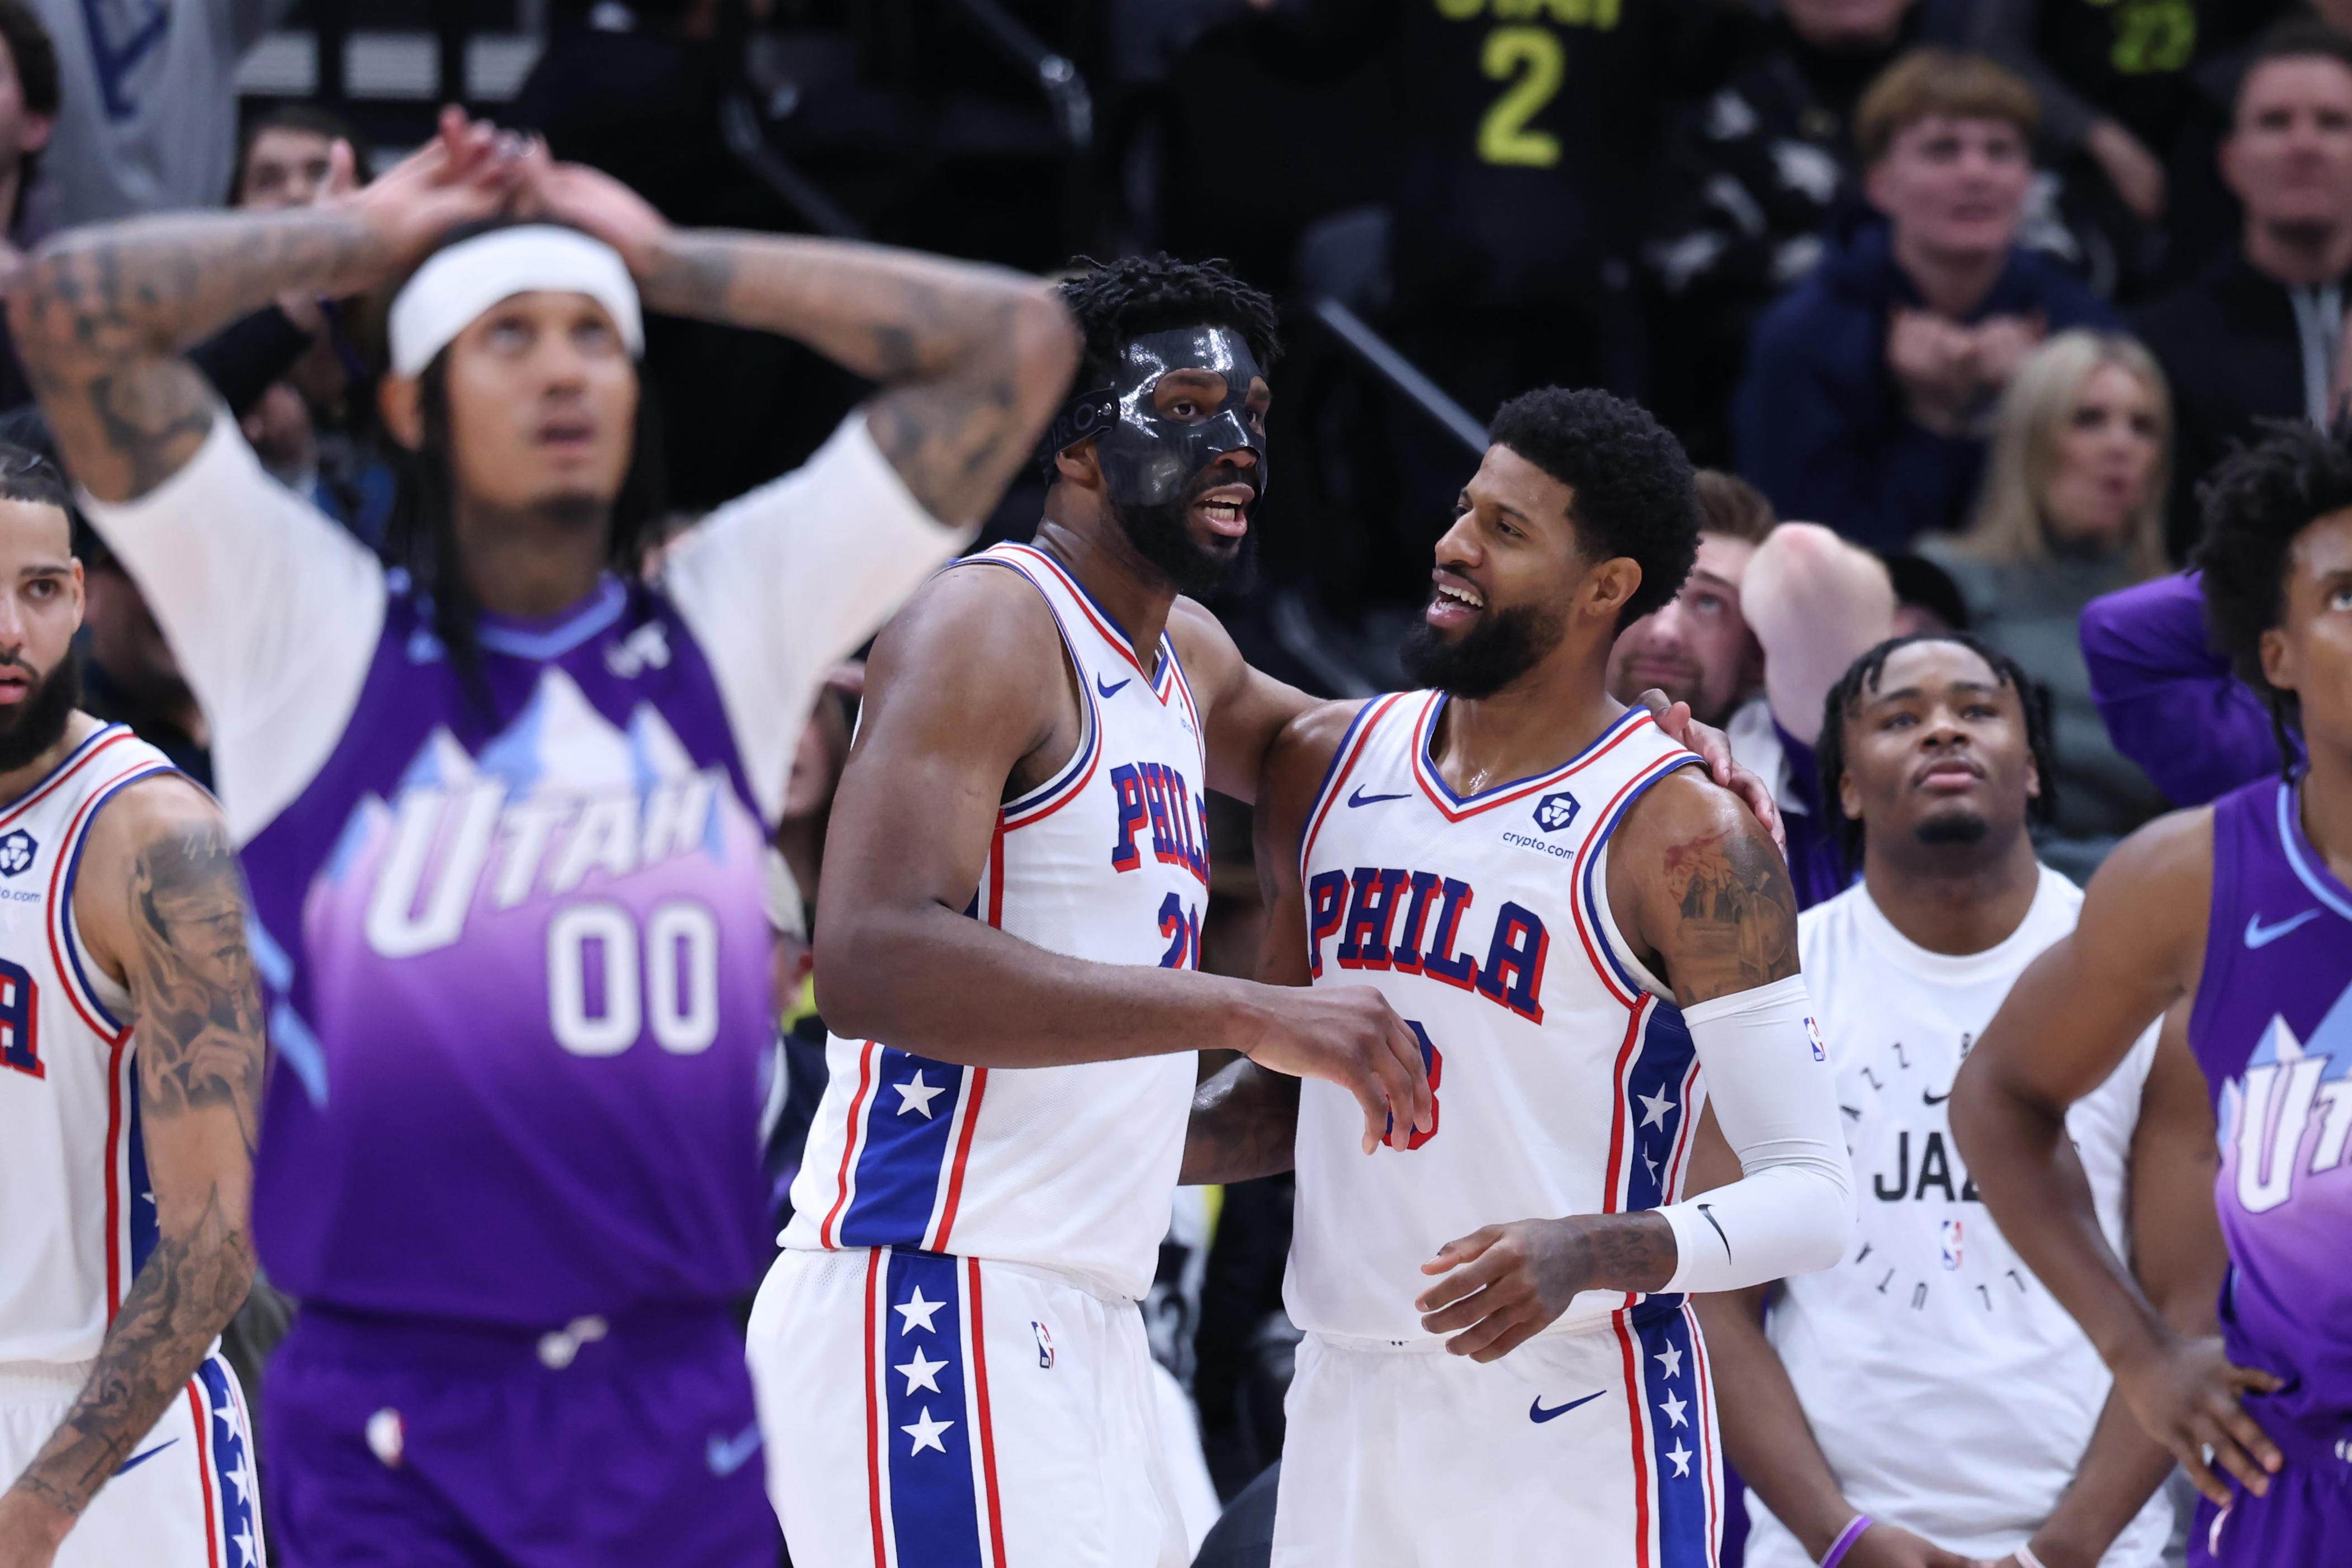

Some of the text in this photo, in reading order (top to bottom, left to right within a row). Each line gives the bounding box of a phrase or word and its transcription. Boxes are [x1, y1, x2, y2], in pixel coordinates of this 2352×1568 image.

[1476, 25, 1565, 169] 2
[362, 776, 717, 960] UTAH
[1502, 830, 1575, 861] crypto.com
[547, 901, 720, 1057] 00
[1309, 867, 1550, 1026] PHILA
[1873, 1130, 1984, 1202] JA
